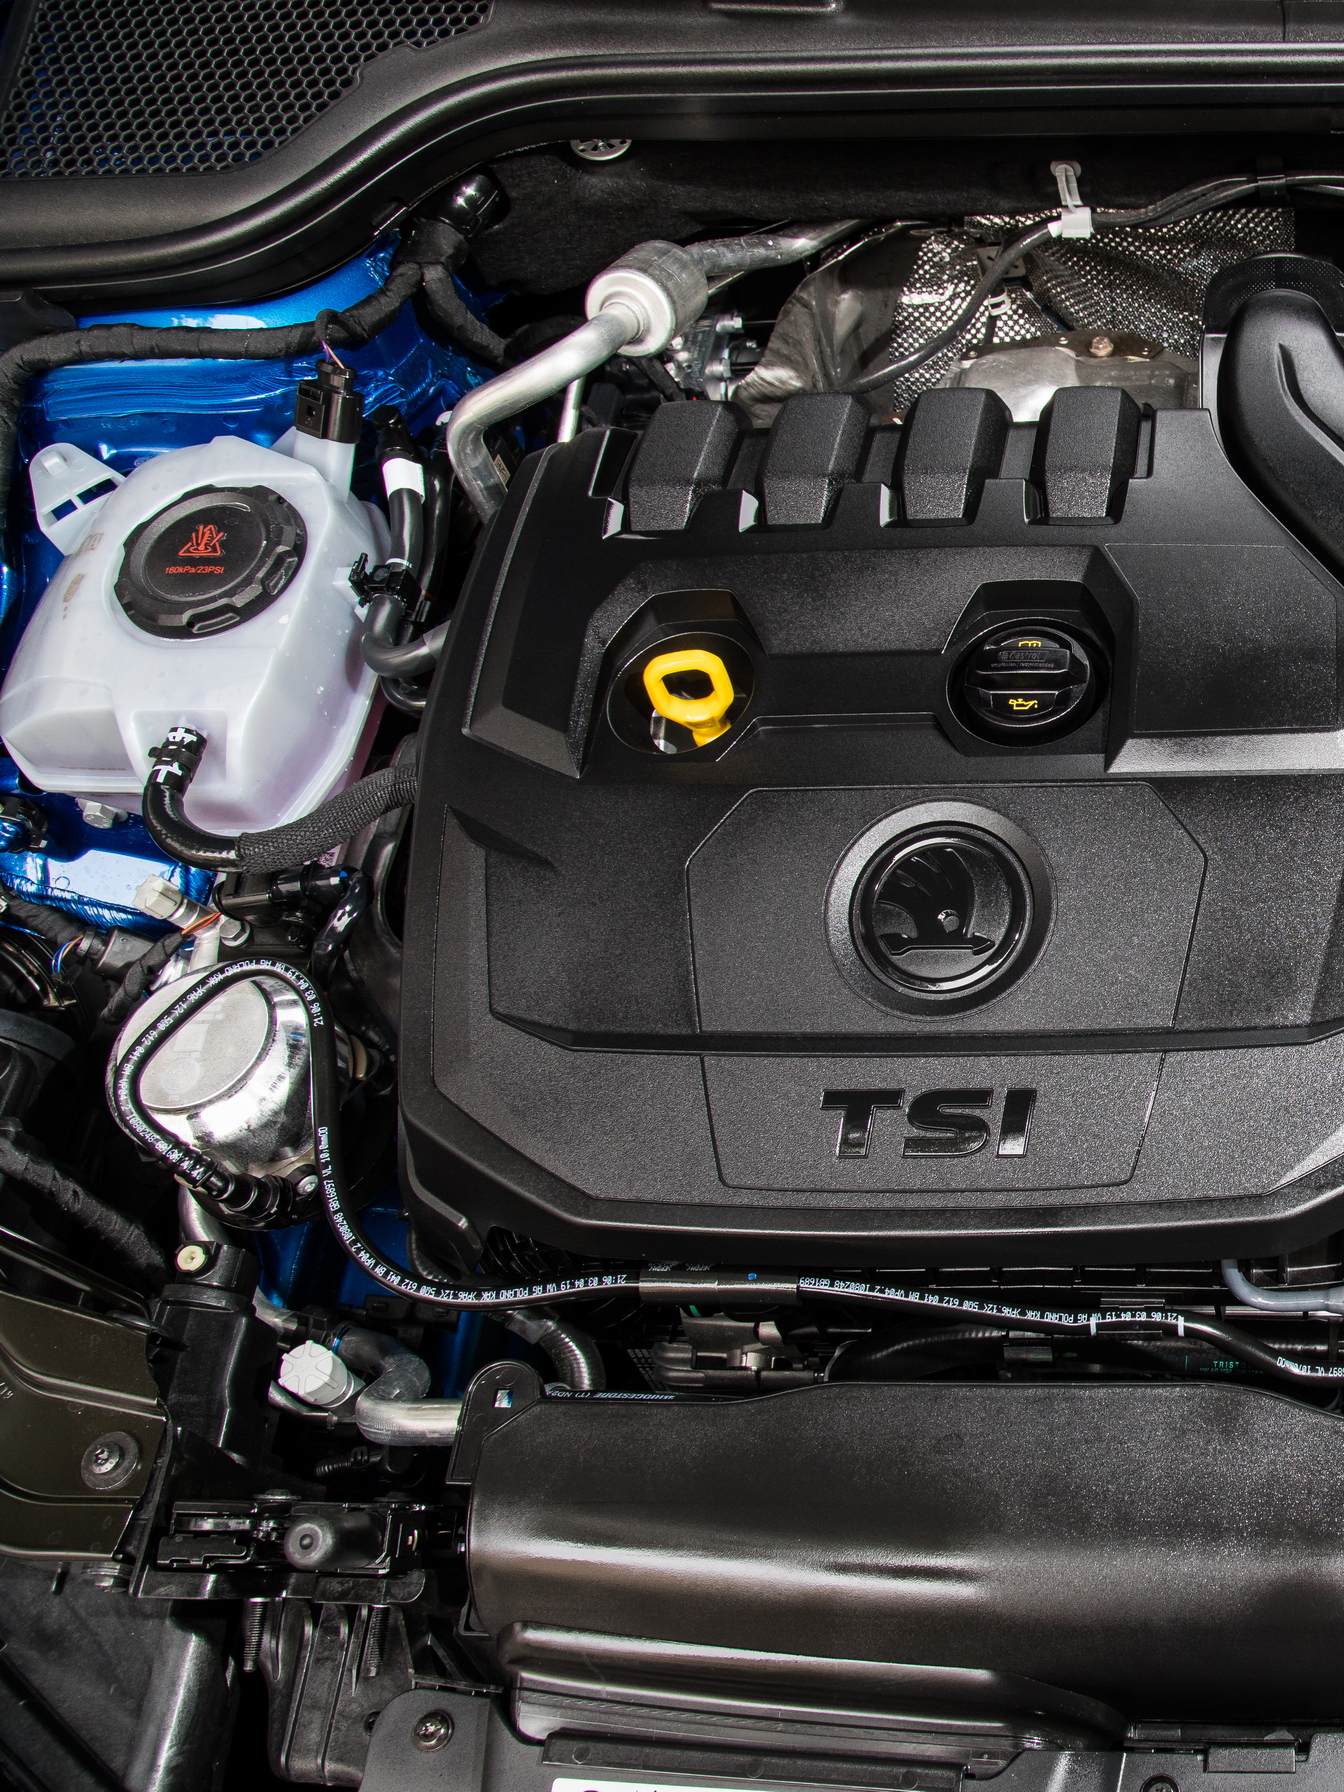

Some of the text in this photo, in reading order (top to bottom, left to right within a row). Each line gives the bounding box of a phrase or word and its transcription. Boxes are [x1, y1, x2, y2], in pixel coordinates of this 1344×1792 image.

[165, 566, 224, 574] 160kPa/23PSI
[224, 959, 256, 976] POLAND
[260, 959, 272, 968] AG
[274, 962, 286, 974] VW
[206, 971, 223, 987] KAK
[287, 969, 317, 1001] 03.04.19
[310, 1002, 325, 1027] 21:06
[141, 1029, 158, 1046] 612
[128, 1045, 145, 1061] 041
[820, 1087, 1037, 1159] TSI
[322, 1165, 332, 1177] VL
[351, 1242, 376, 1269] VP04.2
[374, 1264, 387, 1277] BM
[386, 1271, 401, 1286] 041
[560, 1276, 599, 1291] 03.04.19
[602, 1274, 627, 1285] 21:06
[799, 1277, 831, 1288] GB1689
[401, 1278, 418, 1292] 612
[532, 1284, 543, 1295] AG
[546, 1283, 557, 1294] VW
[481, 1290, 496, 1301] KAK
[500, 1286, 529, 1300] POLAND
[874, 1285, 905, 1299] VP04.2
[908, 1291, 920, 1302] BM
[924, 1293, 939, 1304] 041
[943, 1296, 959, 1307] 612
[1025, 1310, 1041, 1320] KAK
[1044, 1312, 1074, 1324] POLAND
[1077, 1313, 1088, 1324] AG
[1106, 1311, 1147, 1321] 03.04.19
[1151, 1312, 1178, 1322] 21:06
[1315, 1366, 1325, 1376] VL
